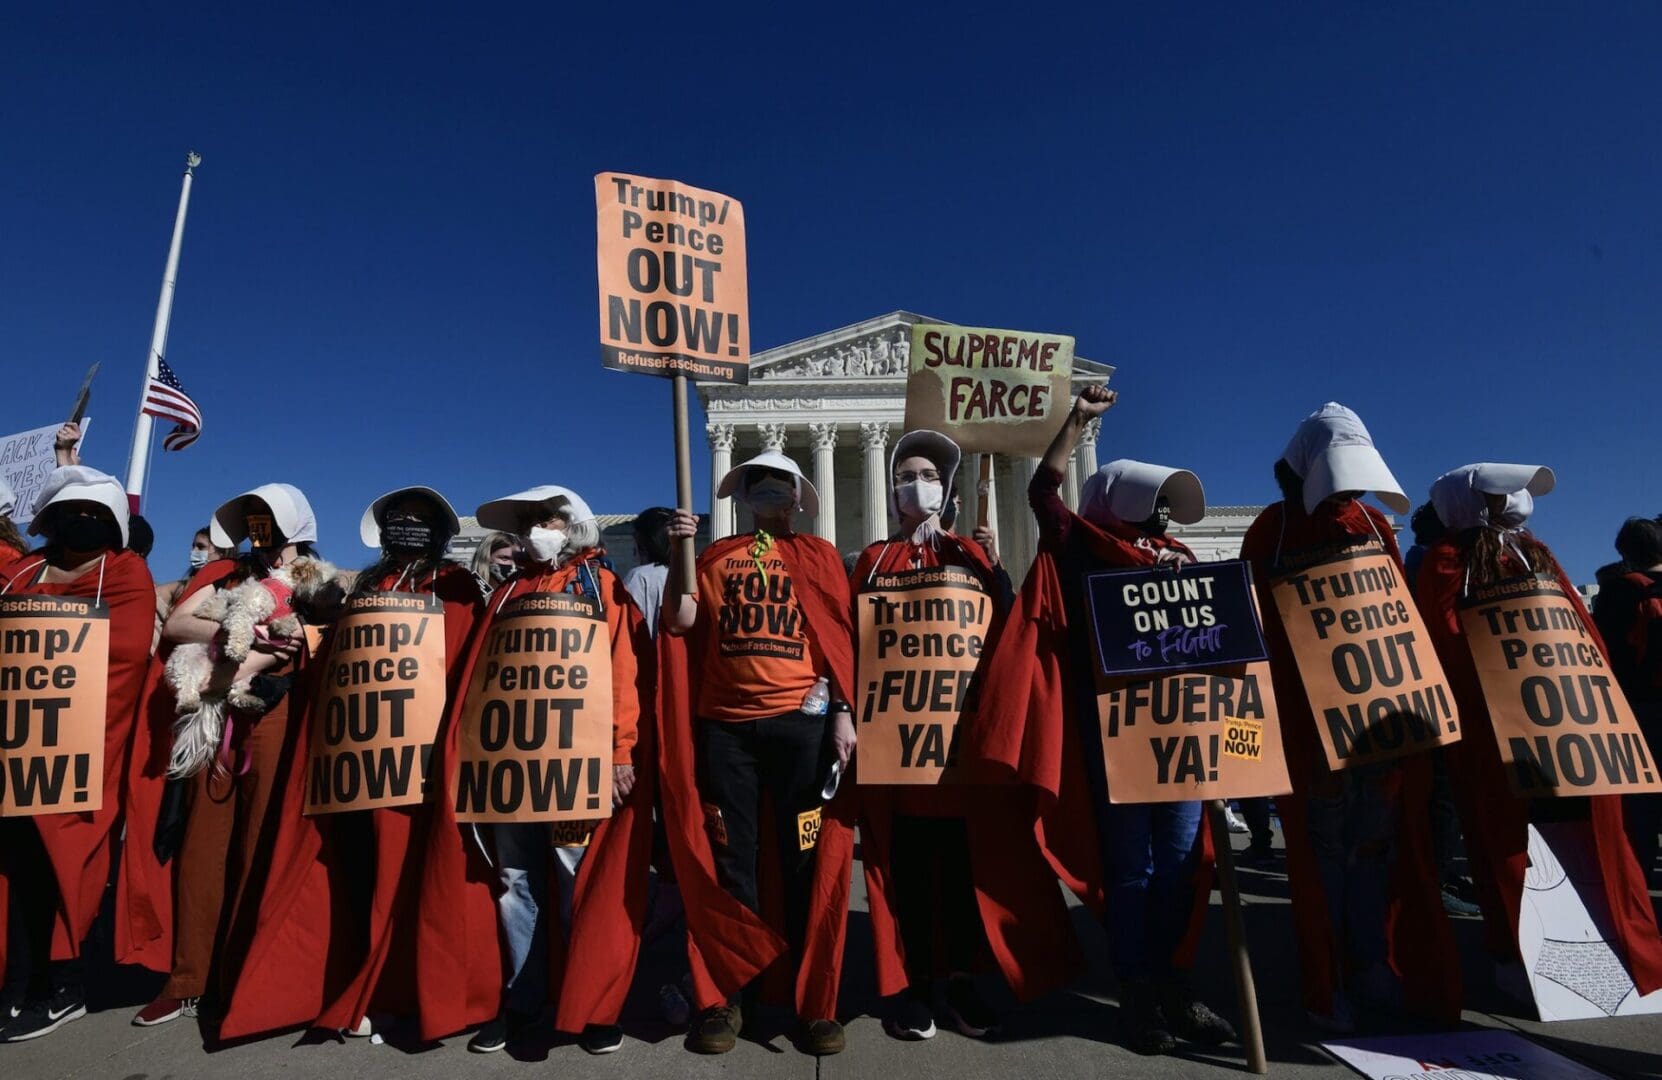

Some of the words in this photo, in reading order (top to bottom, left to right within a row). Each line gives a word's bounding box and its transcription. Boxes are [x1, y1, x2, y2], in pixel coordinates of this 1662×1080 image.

[611, 177, 730, 227] Trump/
[623, 209, 723, 255] Pence
[627, 248, 721, 303] OUT
[608, 295, 739, 356] NOW!
[618, 351, 734, 378] RefuseFascism.org
[924, 332, 1060, 371] SUPREME
[950, 377, 1049, 420] FARCE
[1122, 577, 1214, 606] COUNT
[1287, 558, 1398, 605] Trump/
[869, 596, 985, 629] Trump/
[1134, 609, 1169, 632] ON
[1182, 605, 1216, 628] US
[1310, 599, 1409, 640] Pence
[878, 629, 983, 659] Pence
[1331, 631, 1422, 695] OUT
[1500, 638, 1603, 669] Pence
[483, 664, 588, 692] Pence
[1521, 675, 1618, 727] OUT
[326, 689, 415, 746] OUT
[481, 698, 583, 752] OUT
[1108, 674, 1264, 737] ¡FUERA
[1323, 684, 1457, 760] NOW!
[1225, 740, 1260, 757] NOW
[1228, 727, 1258, 743] OUT
[0, 753, 90, 807] W!
[1150, 735, 1219, 784] YA!
[1508, 733, 1654, 788] NOW!
[455, 758, 600, 814] NOW!
